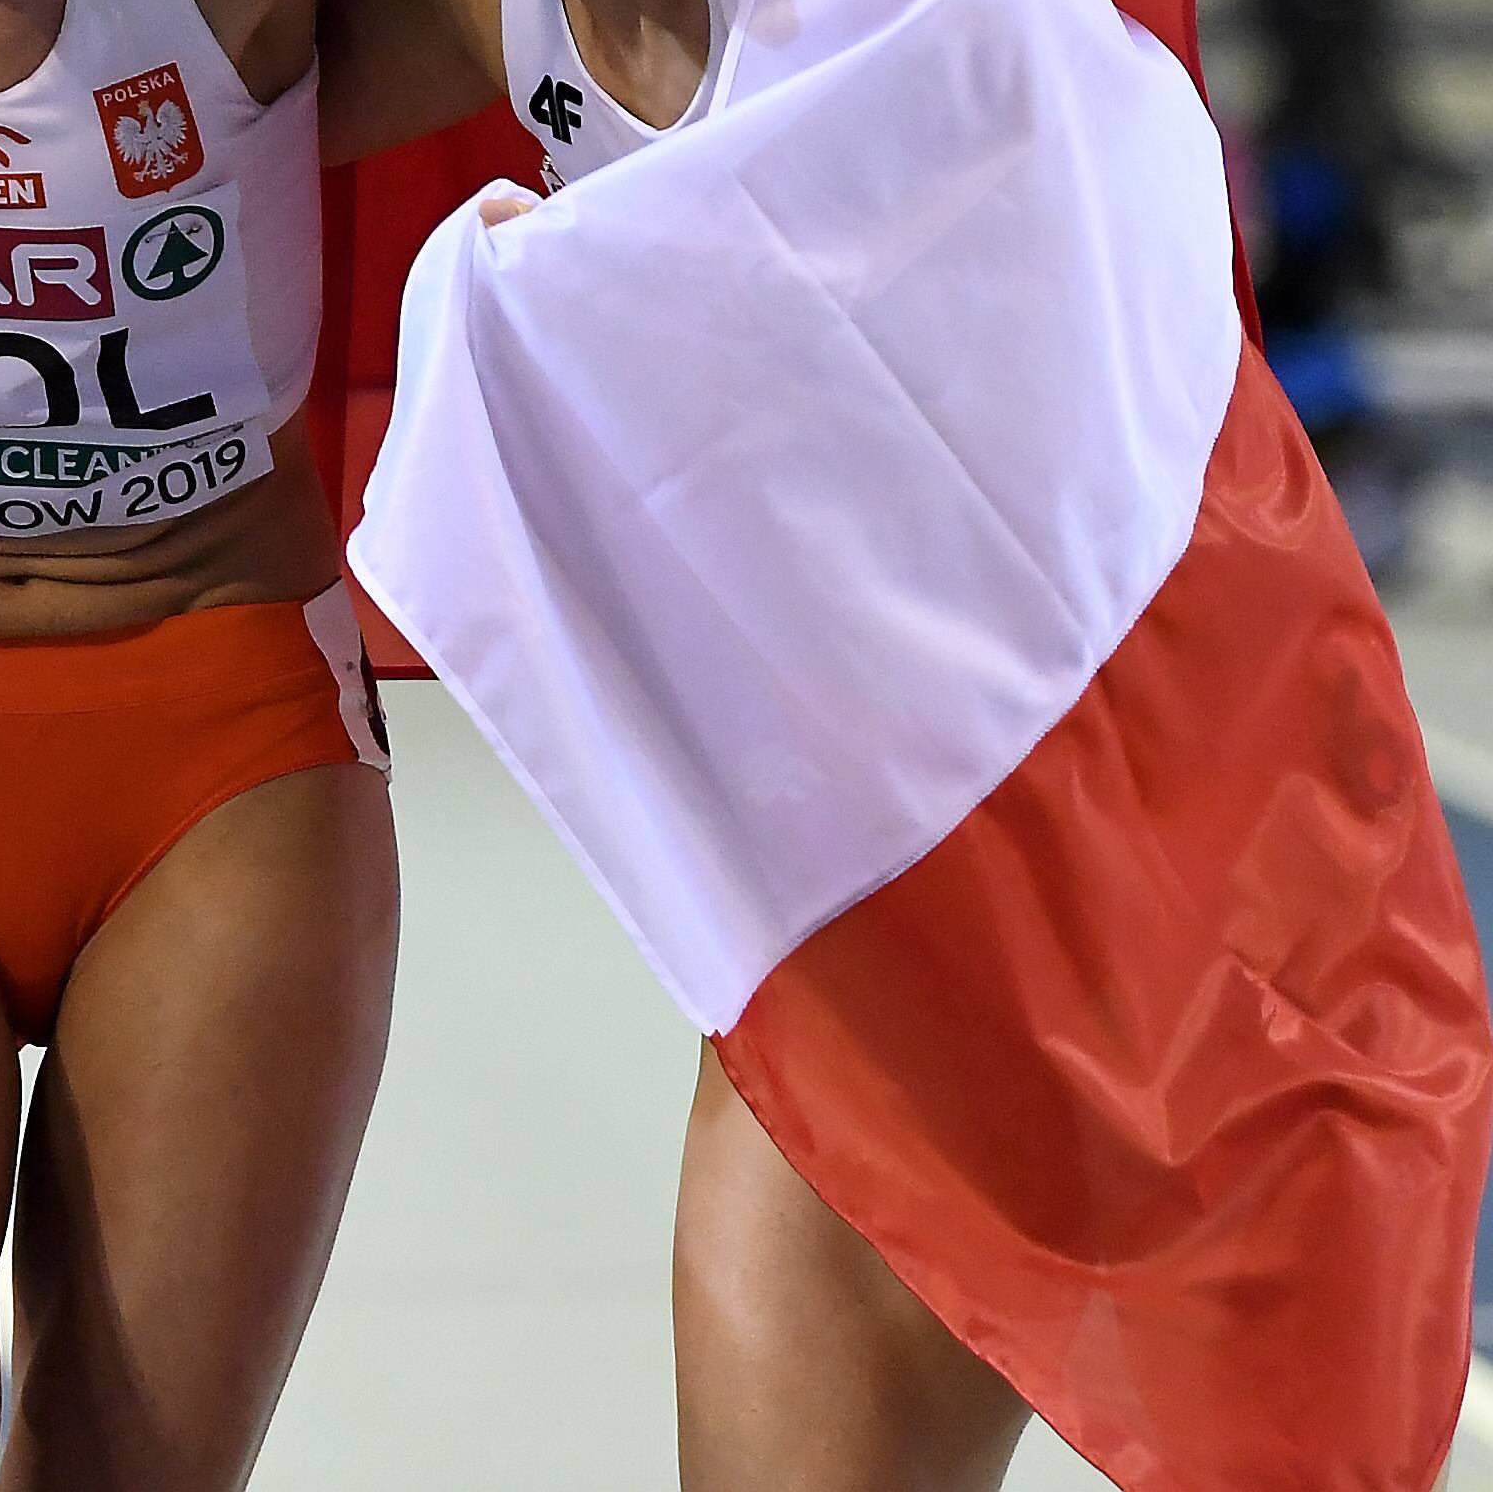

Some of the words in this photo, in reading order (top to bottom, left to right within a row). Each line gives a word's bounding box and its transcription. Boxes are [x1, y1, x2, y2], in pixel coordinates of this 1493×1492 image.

[101, 70, 175, 107] POLSKA
[528, 74, 584, 145] 4F
[121, 440, 247, 518] 2019
